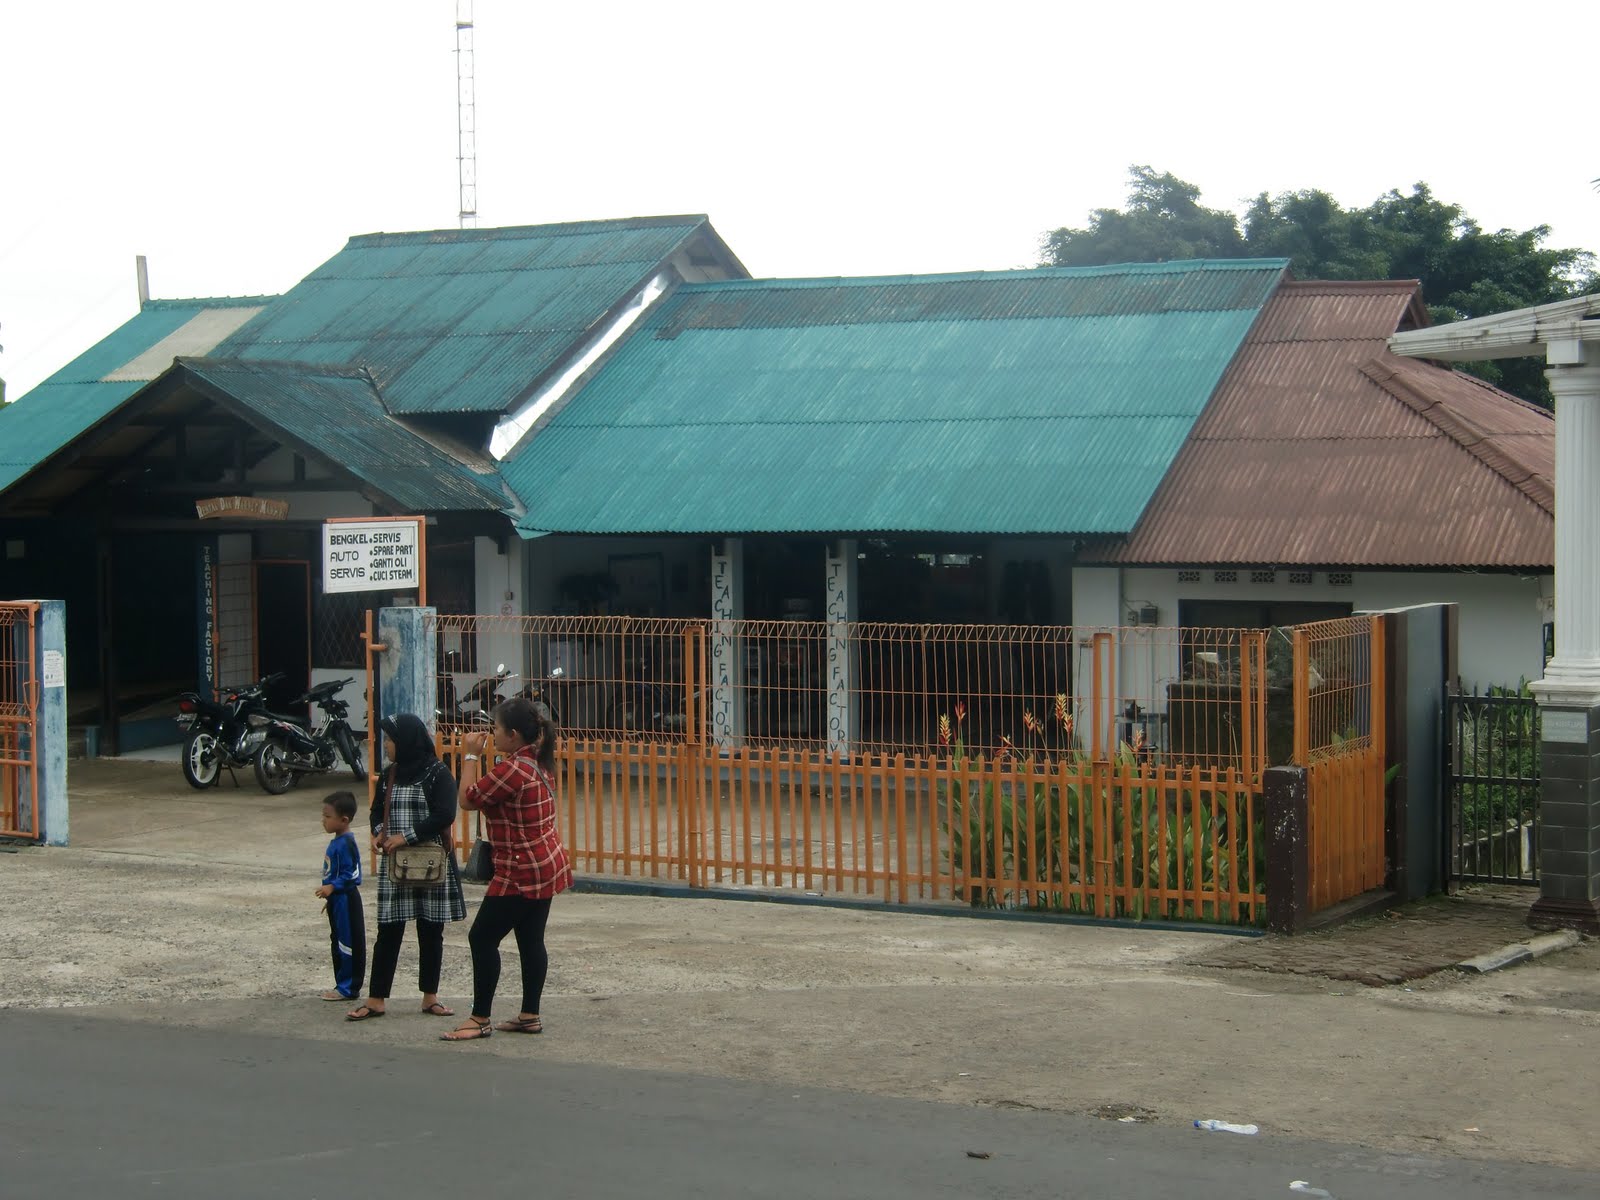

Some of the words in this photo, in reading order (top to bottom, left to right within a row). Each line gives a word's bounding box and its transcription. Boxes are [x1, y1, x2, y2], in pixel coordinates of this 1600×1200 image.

[330, 533, 368, 545] BENGKEL
[373, 532, 401, 544] SERVIS
[330, 550, 359, 562] AUTO
[373, 545, 394, 556] SPARE
[395, 544, 413, 555] PART
[373, 558, 394, 568] GANTI
[394, 557, 407, 567] OLI
[330, 567, 365, 579] SERVIS
[373, 570, 388, 581] CUCI
[389, 569, 413, 580] STEAM
[203, 546, 213, 615] TEACHING
[713, 561, 732, 658] TEACHING
[827, 564, 847, 663] TEACHING
[205, 621, 213, 682] FACTORY
